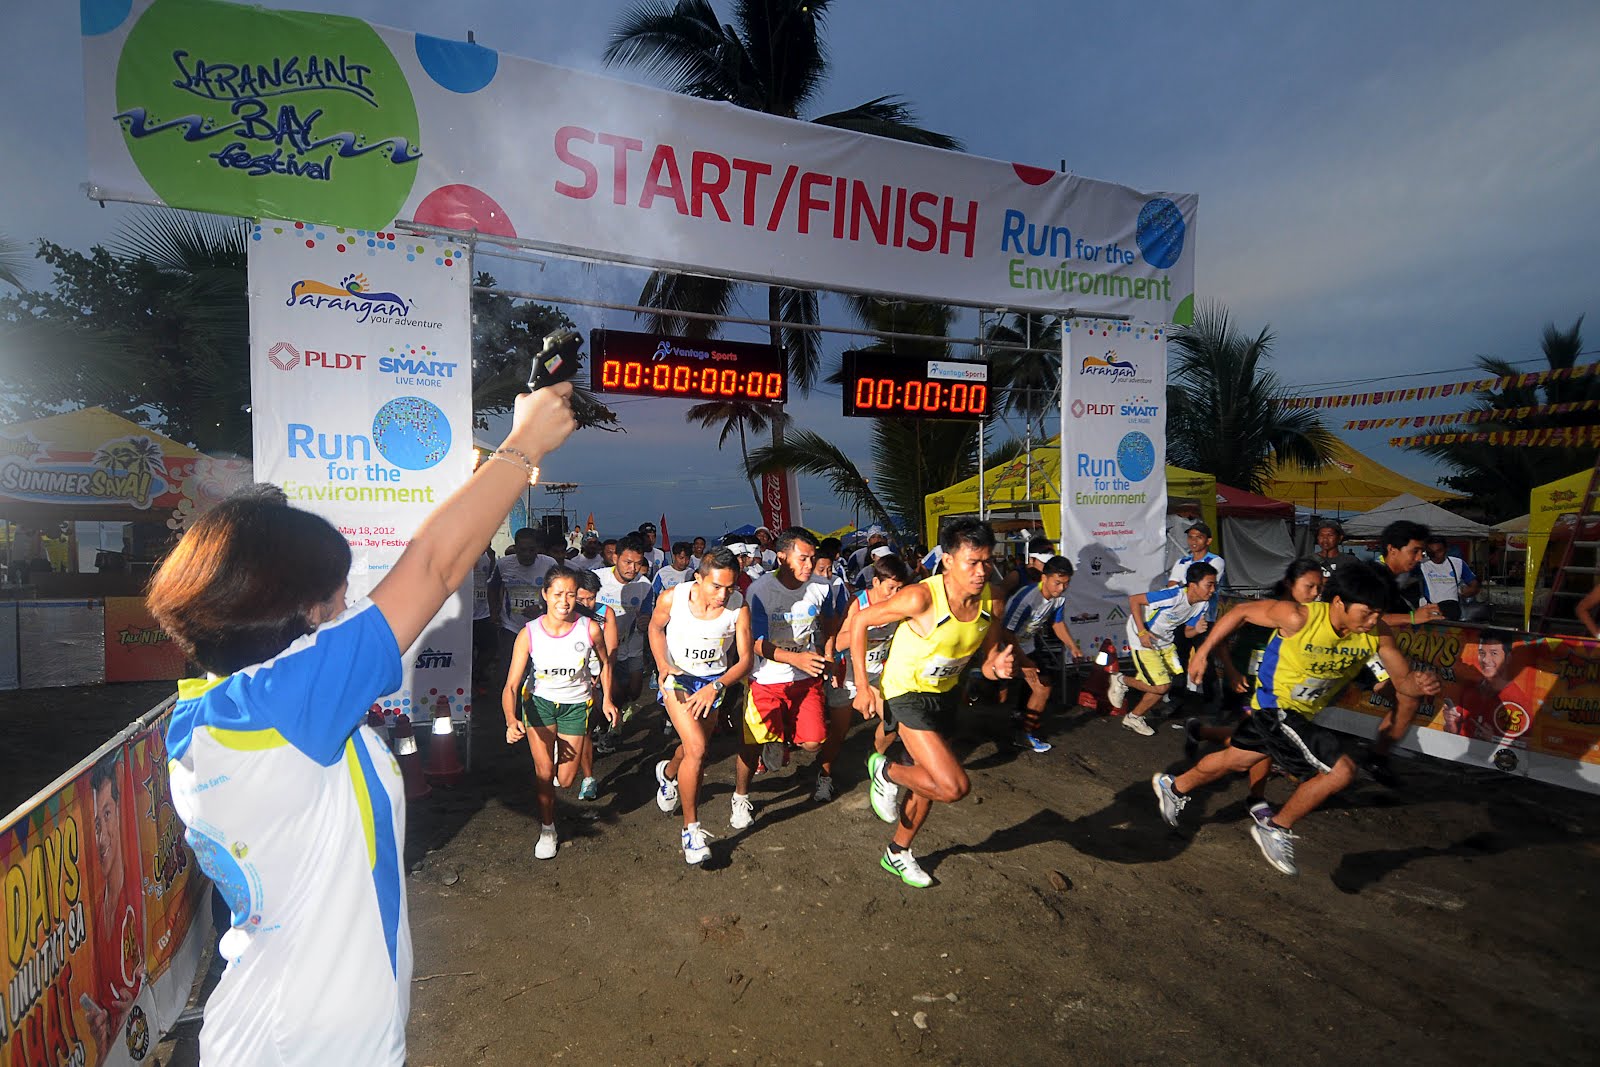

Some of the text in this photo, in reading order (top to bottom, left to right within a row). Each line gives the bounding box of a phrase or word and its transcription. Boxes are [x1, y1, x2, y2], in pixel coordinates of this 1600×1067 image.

[231, 100, 322, 146] BAY
[554, 125, 979, 258] START/FINISH
[1000, 208, 1135, 265] Run for the
[1008, 258, 1172, 302] Environment
[286, 279, 415, 323] Sarangani
[371, 315, 443, 330] your adventure
[305, 350, 367, 371] PLDT
[673, 347, 738, 361] Vantage Sports
[378, 356, 458, 378] SMART
[1080, 356, 1138, 383] Sarangani
[396, 376, 442, 388] LIVE MORE
[602, 360, 782, 398] 00:00:00:00
[856, 377, 986, 413] 00:00:00
[1087, 404, 1116, 416] PLDT
[1120, 405, 1159, 417] SMART
[287, 423, 371, 461] Run
[327, 462, 401, 482] for the
[1077, 453, 1116, 477] Run
[1, 463, 90, 494] SUMMER
[1094, 478, 1130, 491] for the
[282, 480, 434, 503] Environment
[1075, 491, 1146, 505] Environment
[339, 526, 395, 536] May 18, 2012
[381, 538, 411, 547] Festiva
[684, 647, 716, 660] 1508
[1396, 632, 1460, 667] DAYS
[5, 816, 80, 970] DAYS
[9, 901, 86, 1028] UNLITXT SA
